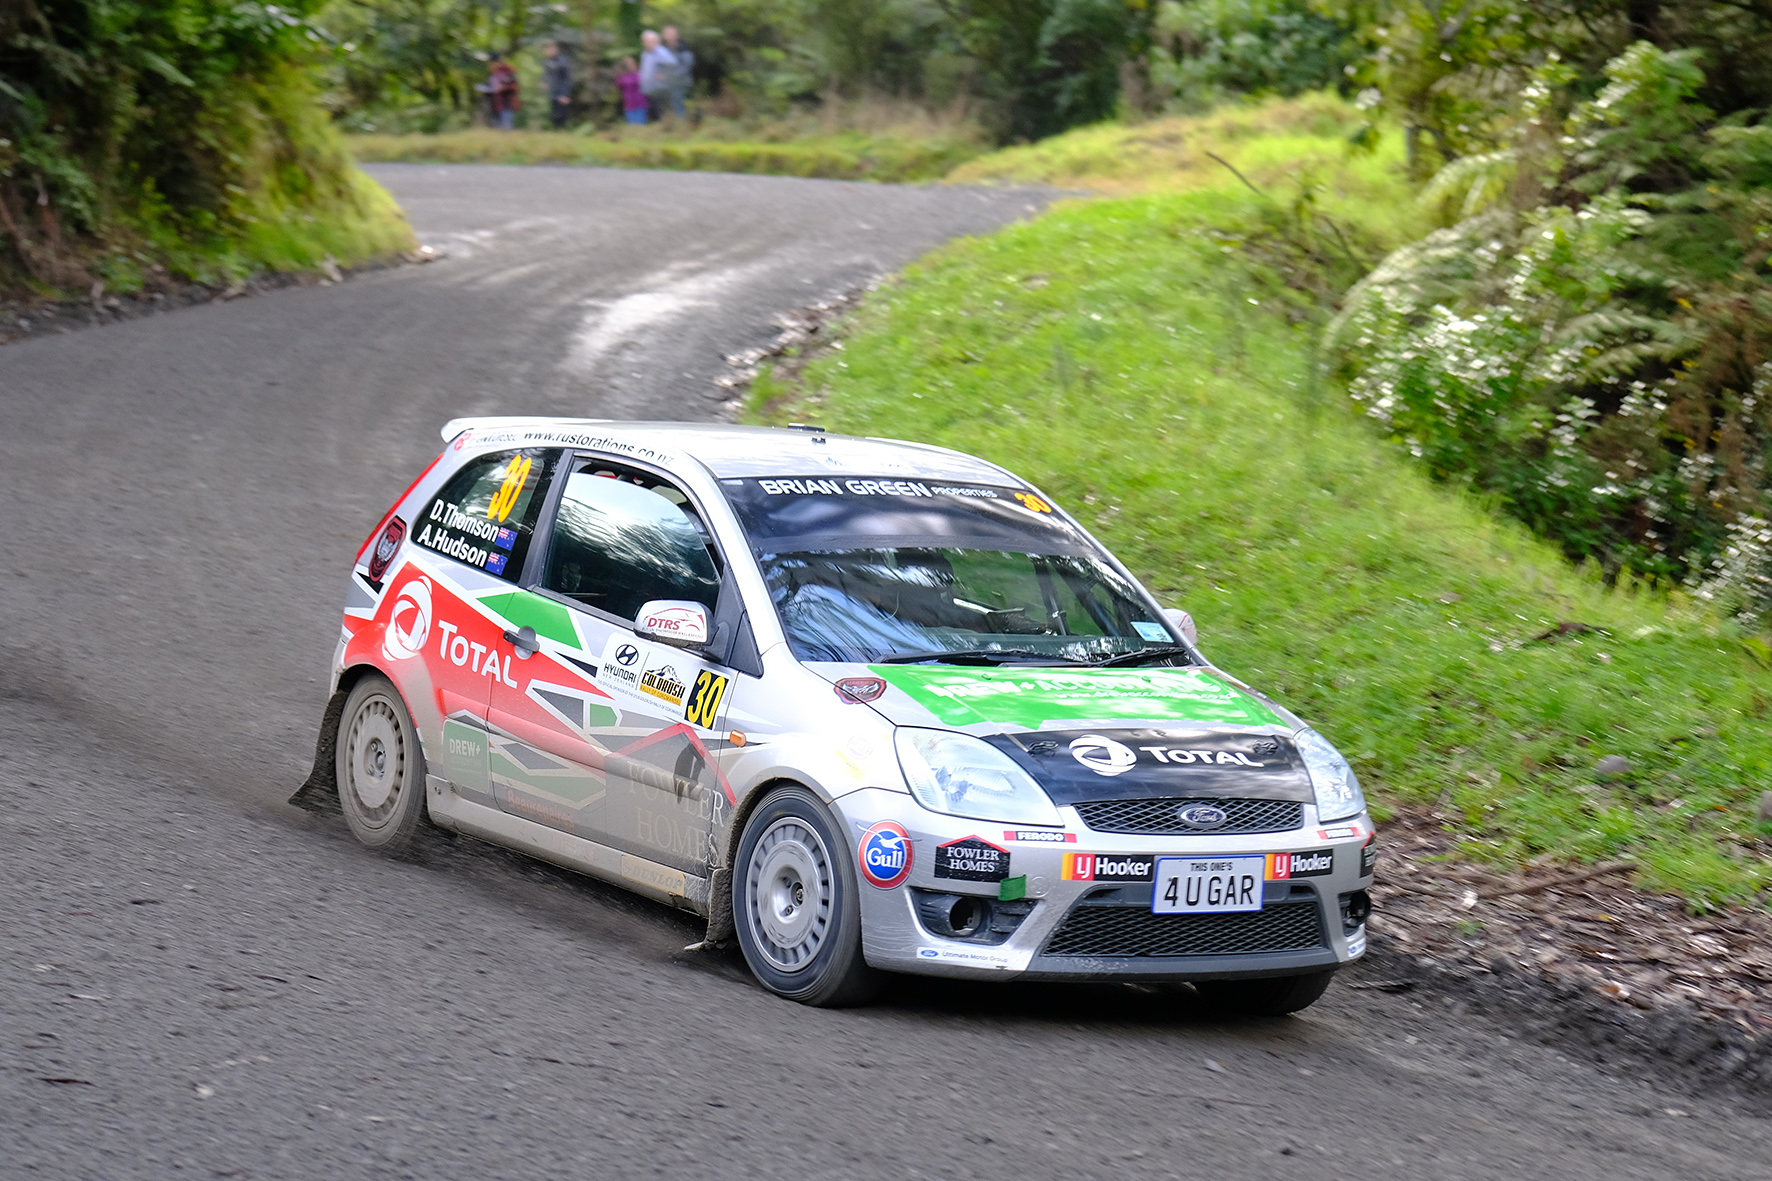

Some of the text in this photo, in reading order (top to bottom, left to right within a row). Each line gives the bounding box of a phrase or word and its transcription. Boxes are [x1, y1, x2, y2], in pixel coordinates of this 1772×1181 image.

[487, 454, 532, 523] 30
[758, 479, 844, 496] BRIAN
[845, 480, 933, 498] GREEN
[1014, 492, 1052, 514] 30
[430, 498, 500, 543] D.Thomson
[417, 523, 488, 568] A.Hudson
[647, 617, 681, 631] DTRS
[438, 619, 518, 690] TOTAL
[603, 662, 637, 684] HYUNDAI
[641, 671, 686, 699] GOLDRUSH
[688, 671, 726, 729] 30
[449, 738, 481, 757] DREW+
[1138, 746, 1265, 768] TOTAL
[626, 760, 725, 828] FOWLER
[1192, 808, 1218, 822] Ford
[635, 805, 723, 868] HOMES
[1017, 831, 1064, 842] FERODO
[867, 847, 903, 869] Gull
[946, 846, 1000, 861] FOWLER
[1290, 853, 1333, 873] Hooker
[949, 858, 996, 873] HOMES
[1076, 856, 1152, 879] LJ Hooker
[1190, 861, 1233, 872] THIS ONE'S
[629, 865, 683, 890] DUNLOP
[1164, 874, 1255, 907] 4UGAR
